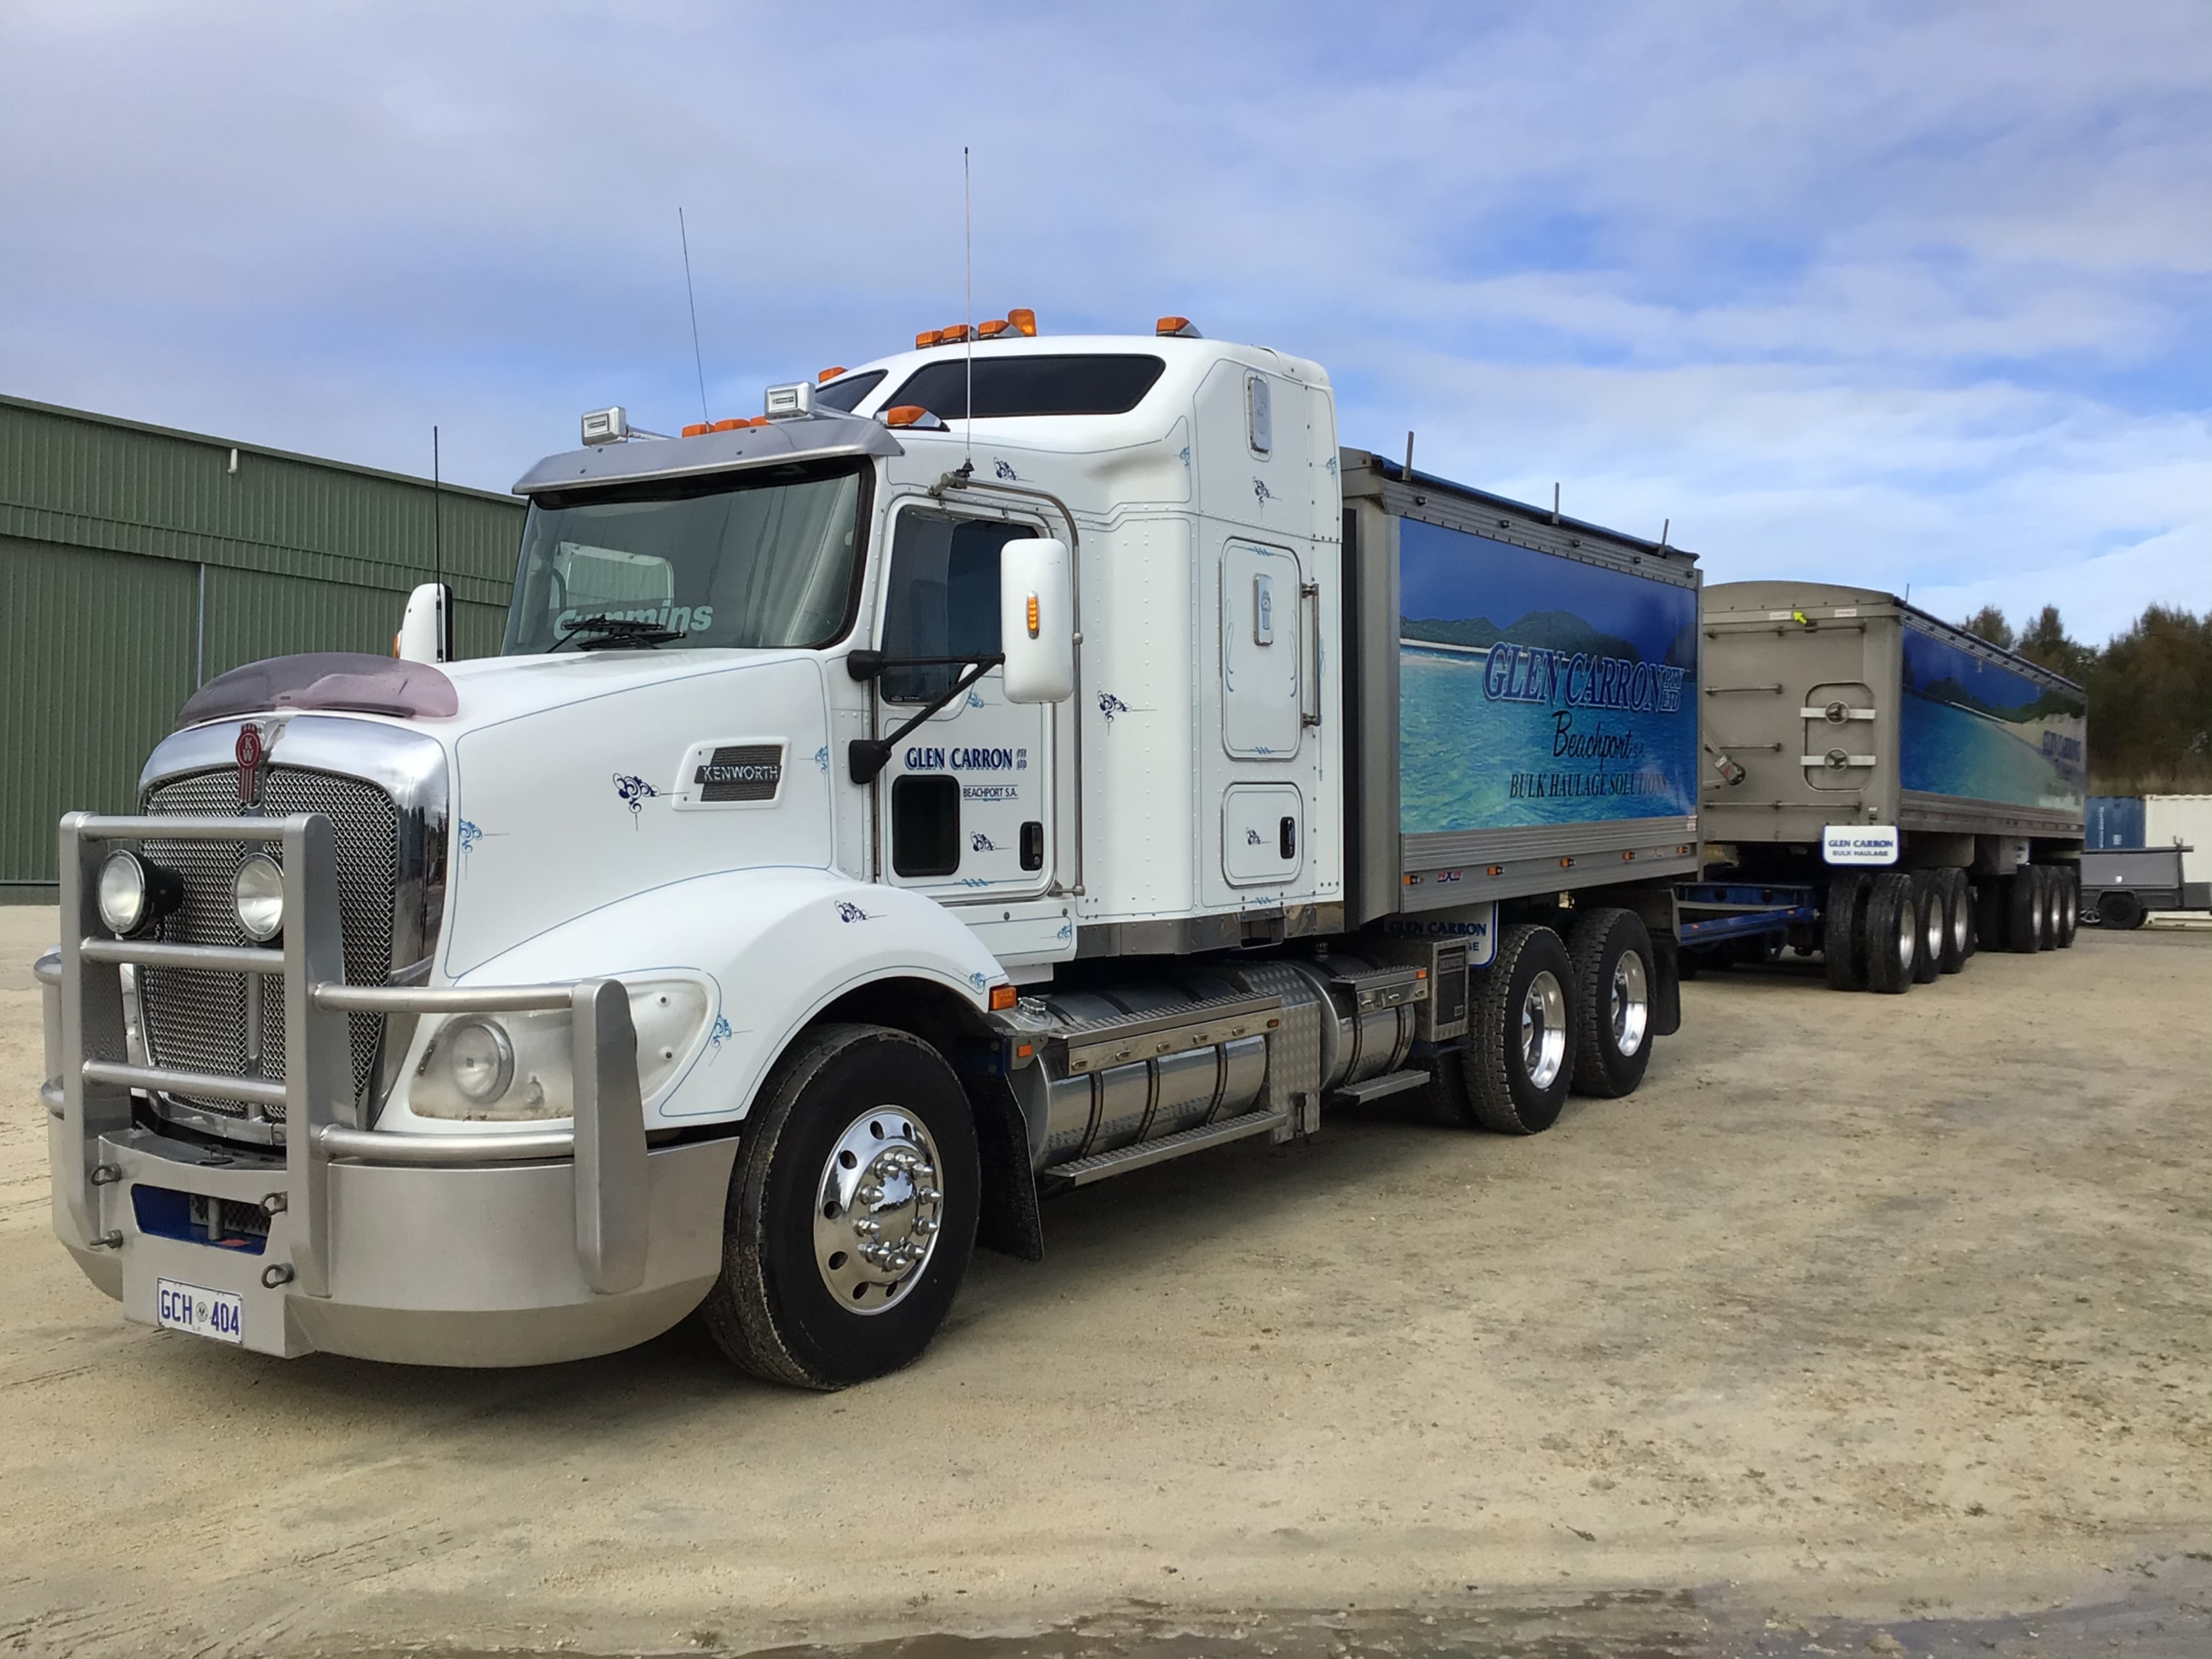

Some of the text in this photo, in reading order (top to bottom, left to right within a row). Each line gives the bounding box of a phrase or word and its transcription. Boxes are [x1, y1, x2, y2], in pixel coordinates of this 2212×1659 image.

[1483, 641, 1662, 712] GLEN CARRON
[1551, 710, 1633, 771] Beachport
[905, 747, 1012, 770] GLEN CARRON
[703, 766, 778, 781] KENWORTH
[1510, 773, 1545, 798] BULK
[1550, 773, 1606, 797] HAULAGE
[963, 787, 1003, 797] BEACHPORT
[1428, 921, 1487, 937] CARRON
[161, 1290, 239, 1336] GCH 404
